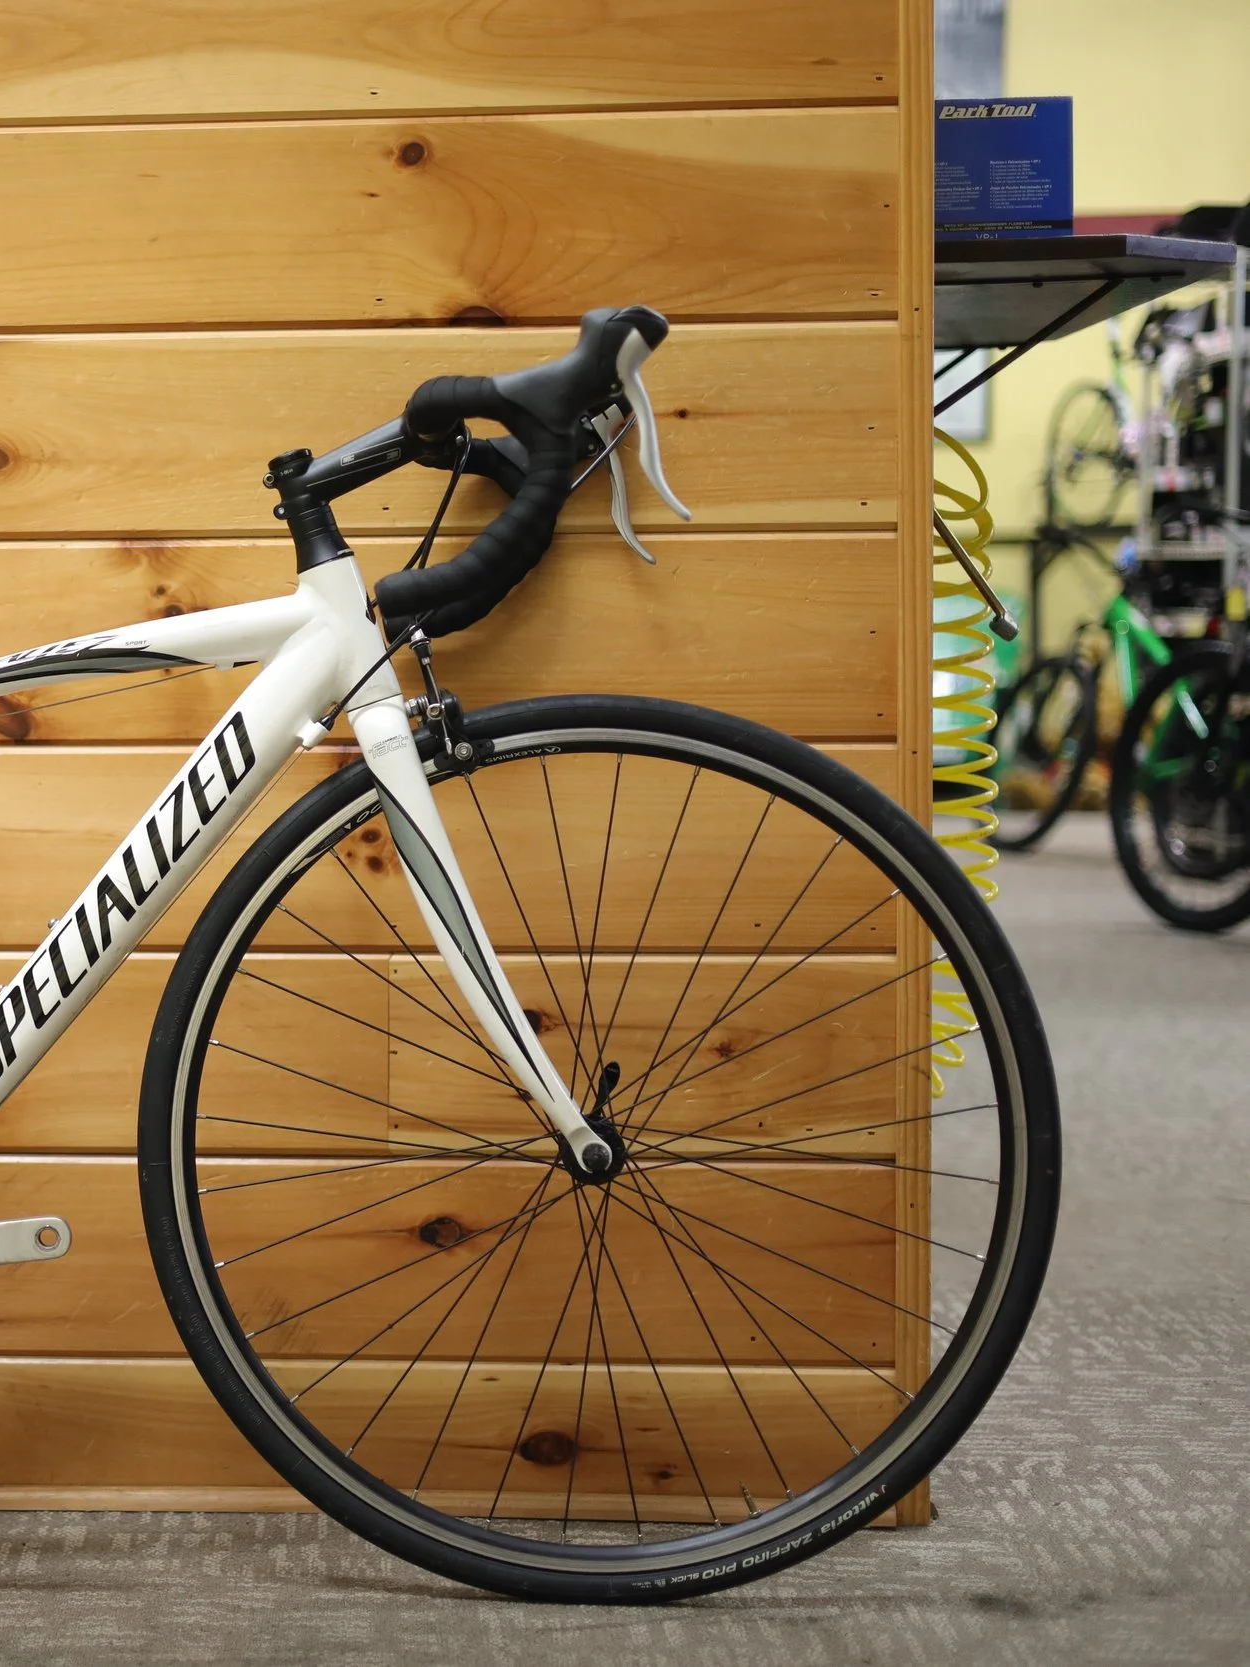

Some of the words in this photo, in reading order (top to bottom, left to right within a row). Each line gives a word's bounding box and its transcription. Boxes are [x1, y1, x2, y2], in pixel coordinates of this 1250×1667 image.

[938, 104, 989, 120] Park
[990, 102, 1038, 118] Tool
[742, 1531, 813, 1569] ZAFFIRO
[670, 1572, 700, 1584] SLICK
[701, 1562, 737, 1580] PRO
